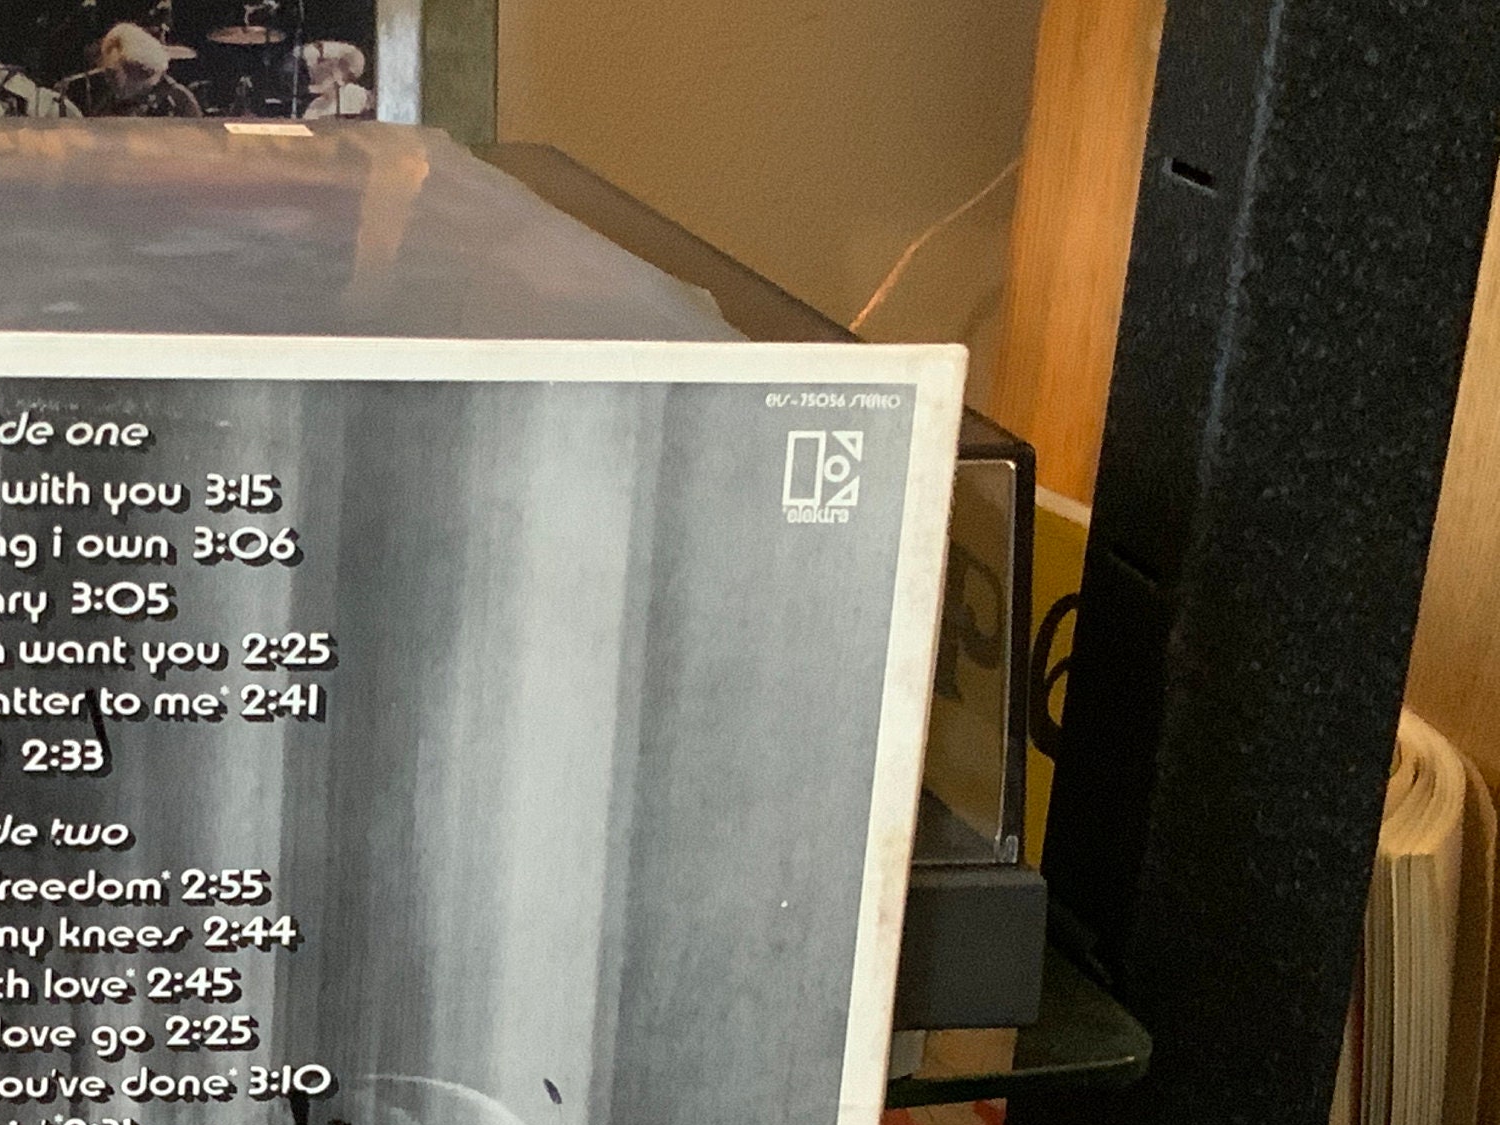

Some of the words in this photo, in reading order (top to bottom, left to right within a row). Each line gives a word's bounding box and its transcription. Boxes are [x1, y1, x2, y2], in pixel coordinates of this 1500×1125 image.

[65, 420, 150, 447] one
[1, 472, 92, 507] with
[104, 480, 182, 514] you
[205, 473, 275, 507] 3:15
[52, 526, 63, 557] i
[76, 533, 170, 559] own
[193, 526, 297, 560] 3:06
[71, 583, 170, 616] 3:05
[18, 635, 128, 666] want
[141, 640, 221, 674] you
[242, 632, 331, 667] 2:25
[100, 686, 142, 716] to
[240, 683, 318, 716] 2:41
[21, 739, 105, 772] 2:33
[50, 818, 129, 847] two
[180, 869, 265, 901] 2:55
[58, 916, 188, 949] knees
[202, 916, 297, 947] 2:44
[146, 967, 234, 998] 2:45
[92, 1024, 147, 1056] go
[165, 1015, 253, 1046] 2:25
[248, 1064, 332, 1096] 3:10
